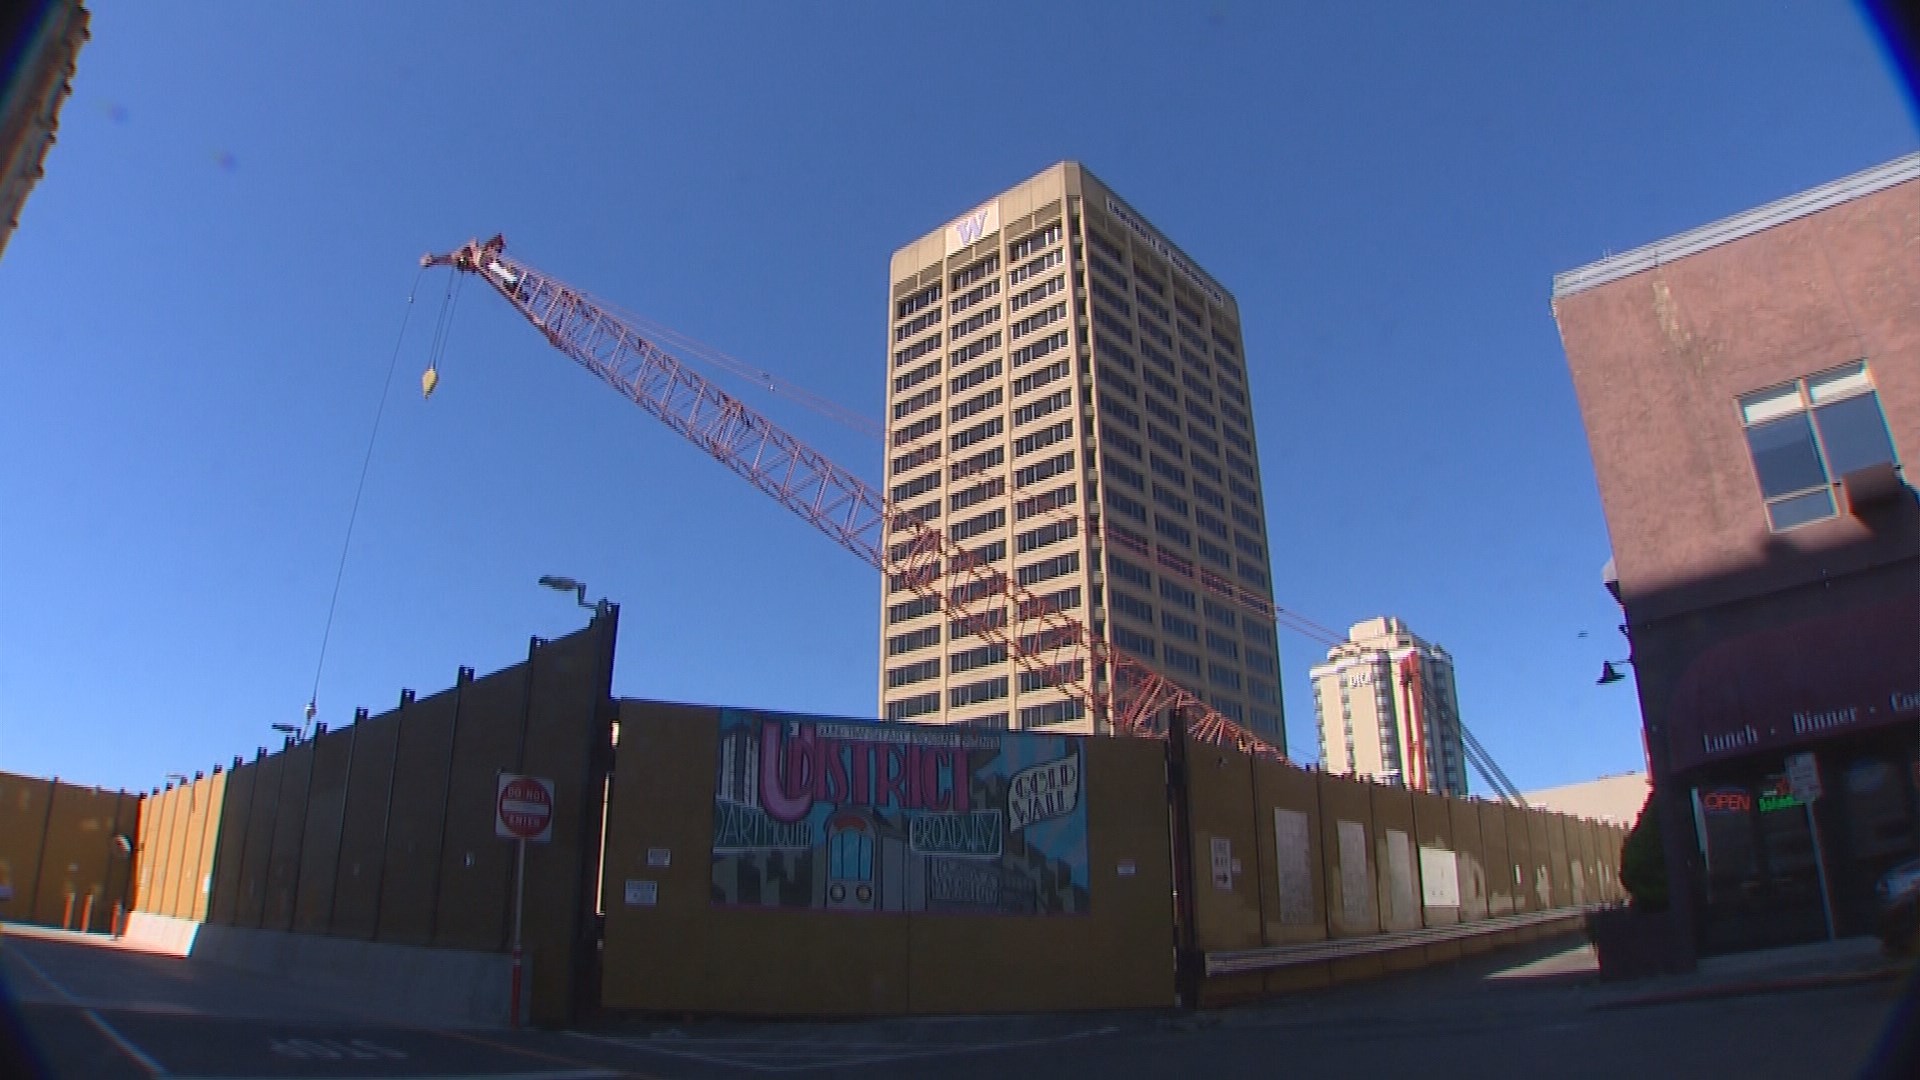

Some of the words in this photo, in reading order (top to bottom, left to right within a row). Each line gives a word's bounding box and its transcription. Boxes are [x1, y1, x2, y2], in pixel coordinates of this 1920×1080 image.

[956, 209, 988, 246] W
[1702, 723, 1758, 753] Lunch
[1791, 704, 1858, 735] Dinner
[507, 786, 521, 798] DO
[1703, 792, 1751, 813] OPEN
